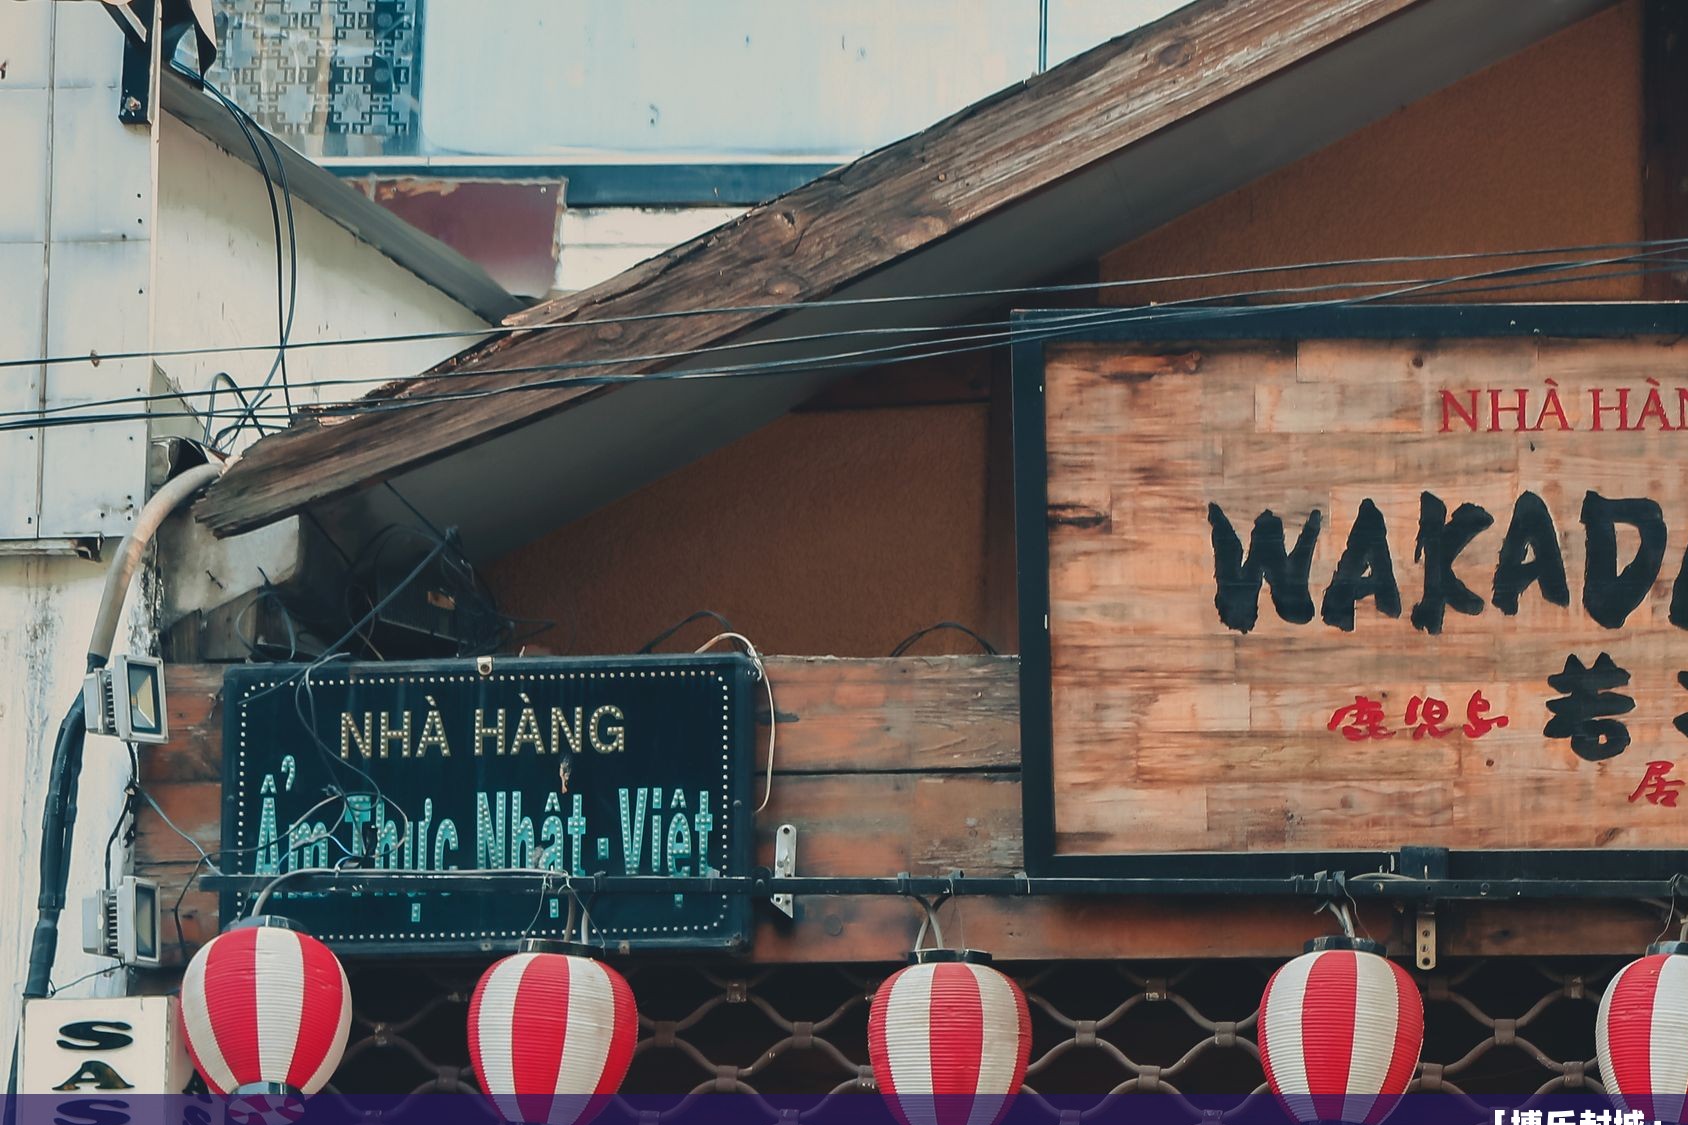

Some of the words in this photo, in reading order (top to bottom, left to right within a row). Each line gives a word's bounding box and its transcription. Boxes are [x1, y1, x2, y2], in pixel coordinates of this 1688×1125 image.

[1438, 377, 1568, 432] NHÀ
[340, 694, 451, 759] NHÀ
[473, 692, 626, 757] HÀNG
